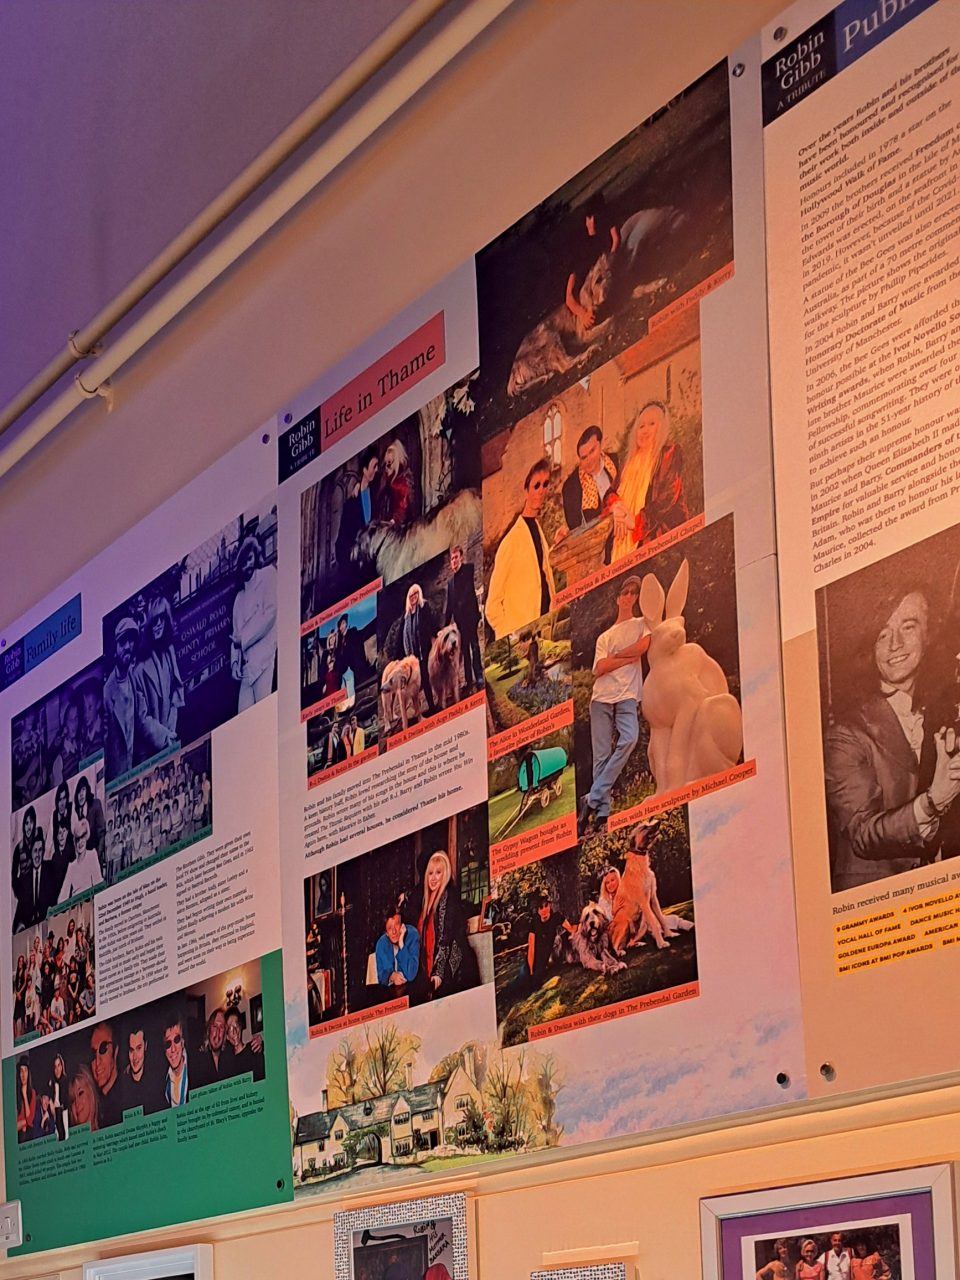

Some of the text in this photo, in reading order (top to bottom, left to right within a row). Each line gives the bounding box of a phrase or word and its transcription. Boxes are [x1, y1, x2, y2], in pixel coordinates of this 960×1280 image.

[775, 30, 826, 78] Robin
[780, 52, 822, 90] Gibb
[777, 101, 784, 112] A
[798, 47, 950, 156] Over the years Robin and his brothers
[798, 53, 958, 168] have been honoured and recognised for
[800, 153, 849, 192] music world.
[324, 345, 435, 439] Life in Thame
[289, 420, 316, 446] Robin
[291, 434, 314, 456] Gibb
[26, 615, 76, 662] Family life
[490, 740, 498, 748] The
[499, 734, 511, 744] Alice
[518, 714, 549, 734] Wonderland
[550, 707, 570, 719] Garden,
[610, 817, 628, 828] Robin
[628, 810, 643, 820] with
[644, 804, 659, 815] Hare
[691, 788, 700, 797] by
[700, 776, 727, 796] Michael
[728, 767, 754, 782] Cooper
[492, 848, 501, 856] The
[502, 841, 519, 851] Gypsy
[520, 833, 538, 845] Wagon
[539, 825, 558, 837] bought
[496, 850, 519, 863] wedding
[520, 842, 540, 856] present
[541, 836, 554, 846] from
[556, 829, 572, 840] Robin
[832, 873, 948, 915] Robin received many musical
[908, 903, 923, 912] IVOR
[924, 895, 953, 907] NOVELLO
[837, 936, 857, 945] VOCAL
[858, 931, 873, 940] HALL
[884, 923, 901, 933] FAME
[841, 919, 868, 930] GRAMMY
[869, 911, 894, 923] AWARDS
[910, 909, 954, 926] DANCE MUSIC
[924, 922, 958, 936] AMERICAN
[838, 934, 915, 959] GOLDENE EUROPA AWARD
[851, 960, 870, 969] ICONS
[879, 954, 891, 962] BMI
[892, 950, 905, 958] POP
[906, 943, 932, 954] AWARDS
[530, 1029, 546, 1038] Robin
[553, 1022, 572, 1032] Dwina
[573, 1017, 586, 1026] with
[587, 1014, 602, 1022] their
[602, 1010, 617, 1019] dogs
[625, 1004, 638, 1012] The
[639, 993, 671, 1008] Prebendal
[671, 989, 697, 1003] Garden
